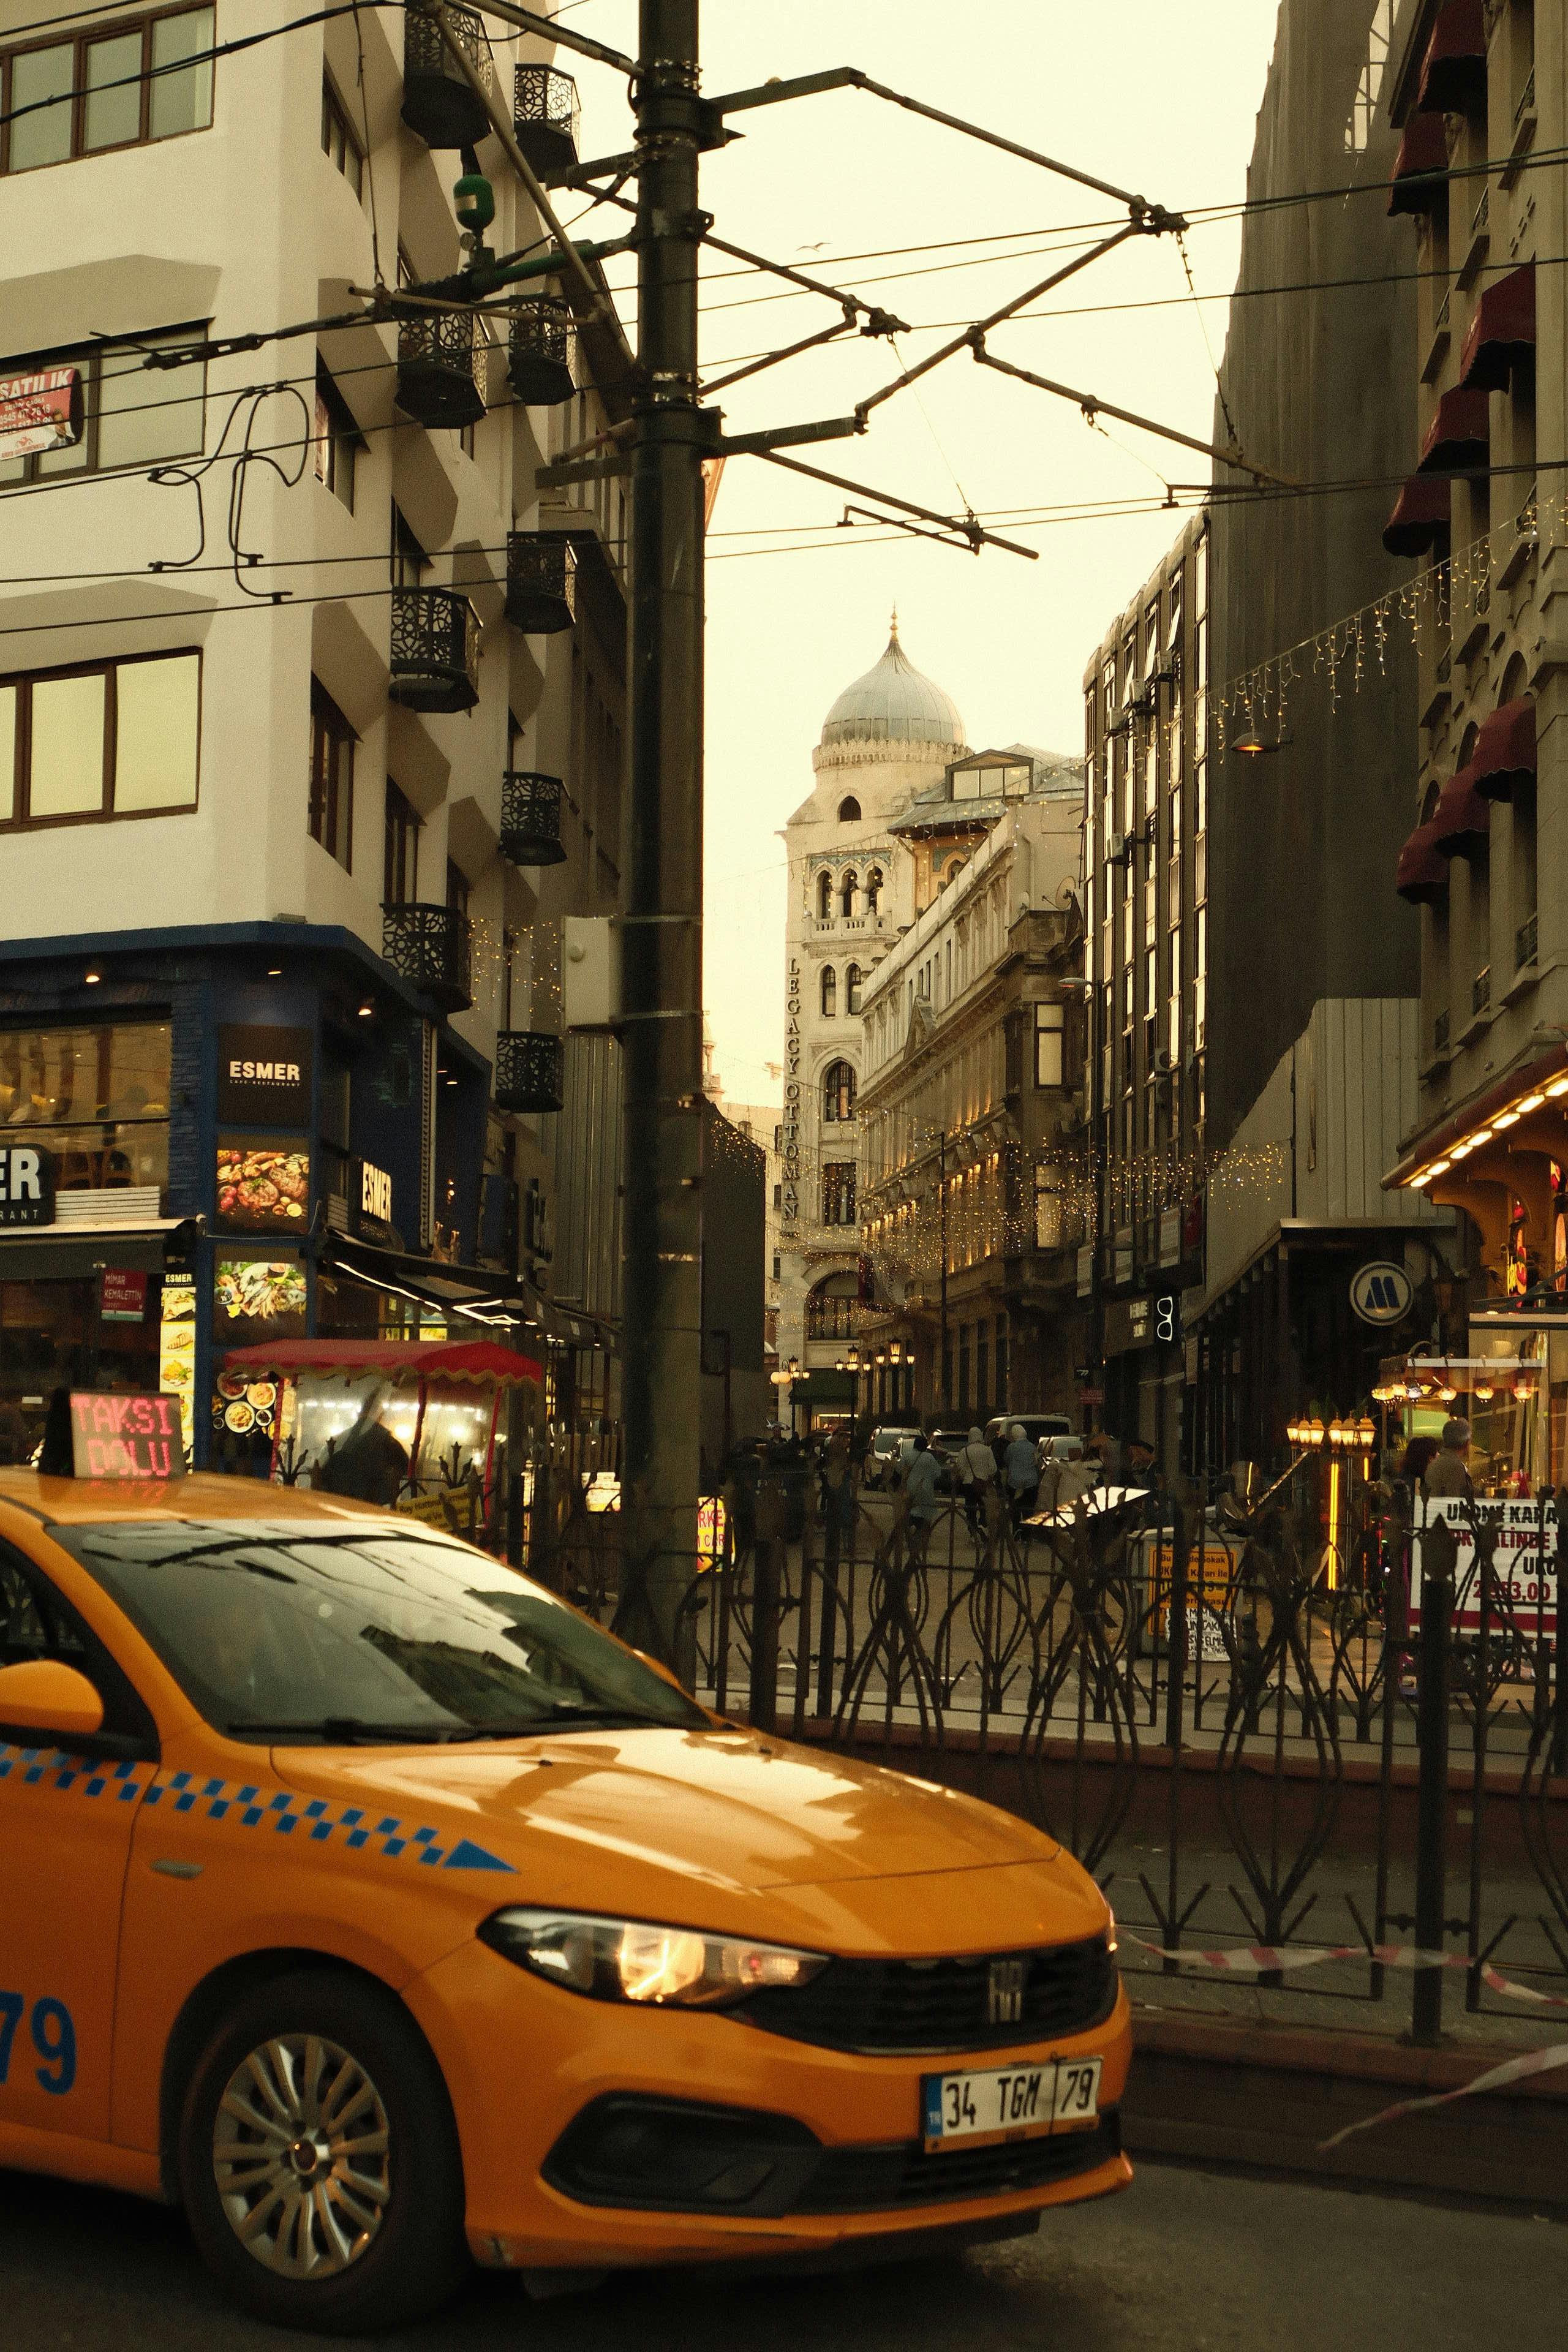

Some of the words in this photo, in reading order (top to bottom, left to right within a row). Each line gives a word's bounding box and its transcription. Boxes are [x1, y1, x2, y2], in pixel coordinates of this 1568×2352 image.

[0, 369, 72, 401] SATILIK
[786, 958, 801, 1074] LEGACY
[230, 1061, 300, 1080] ESMER
[783, 1084, 800, 1219] OTTOMAN
[362, 1161, 392, 1223] ESMER
[165, 1273, 192, 1283] ESMER
[0, 1990, 78, 2096] 79
[946, 2082, 976, 2128] 34
[1060, 2068, 1094, 2113] 79
